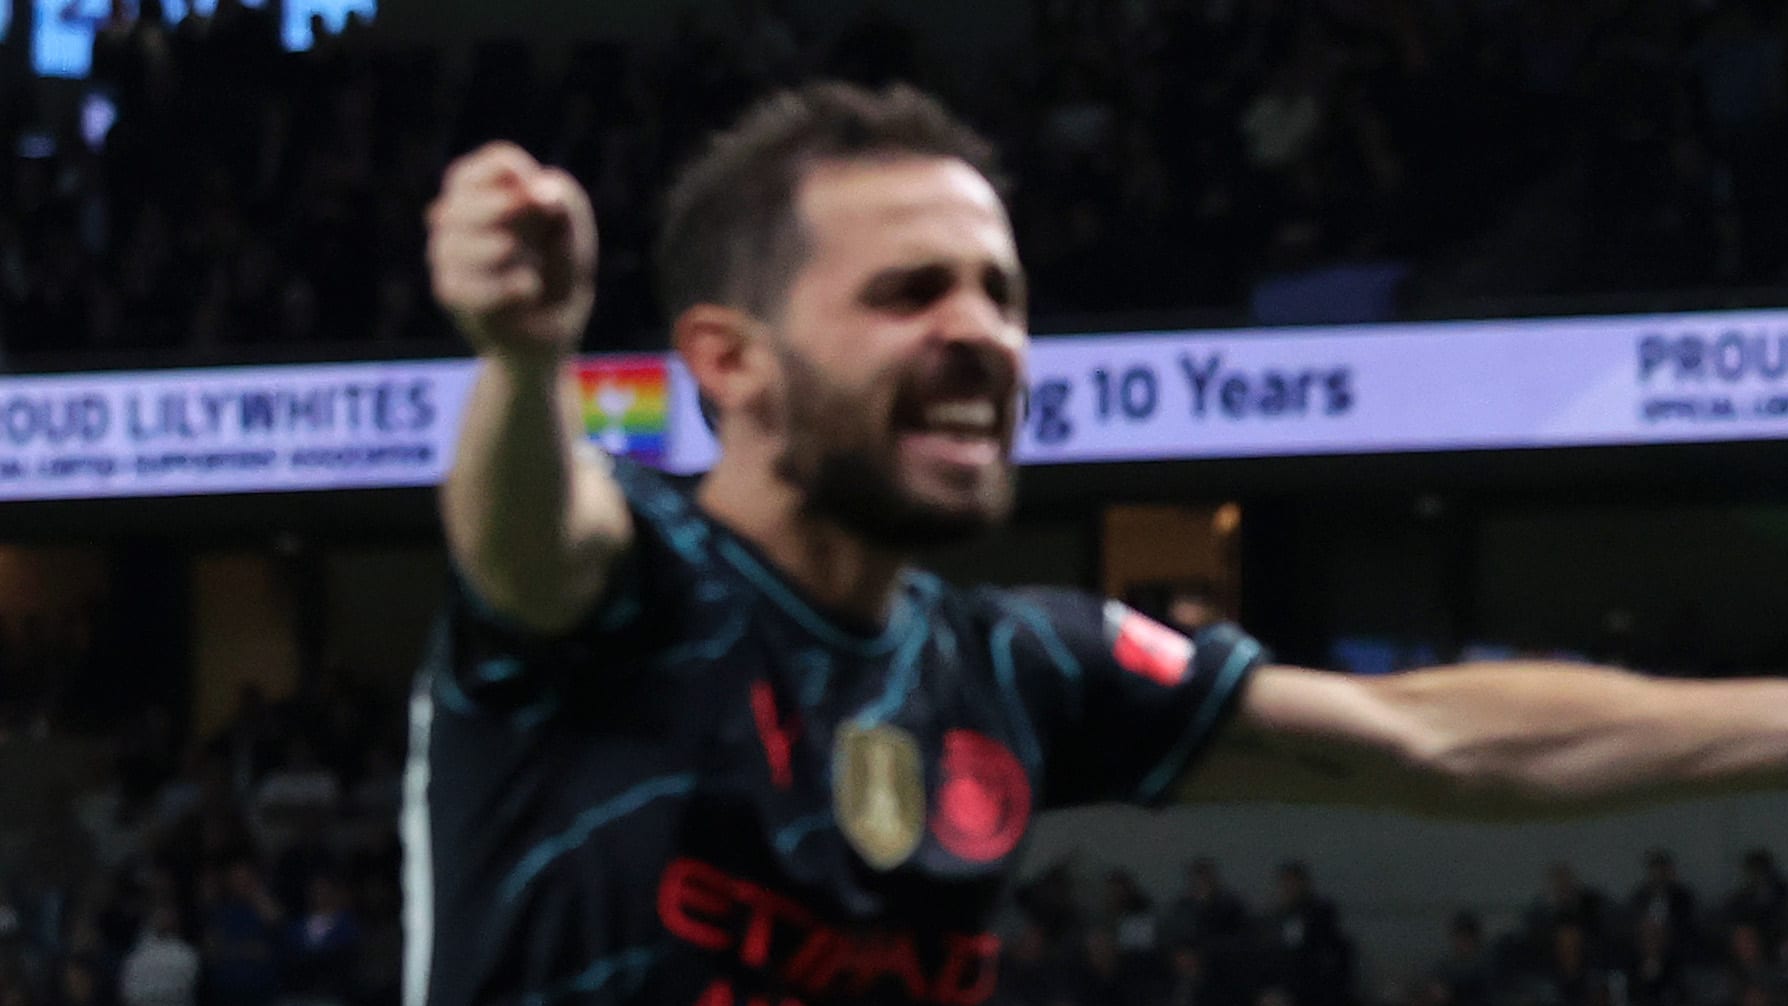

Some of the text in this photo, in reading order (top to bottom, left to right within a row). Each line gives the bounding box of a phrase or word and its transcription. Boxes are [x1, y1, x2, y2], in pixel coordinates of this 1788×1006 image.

[1092, 366, 1158, 422] 10
[1176, 350, 1354, 421] Years
[2, 392, 109, 444] OUD
